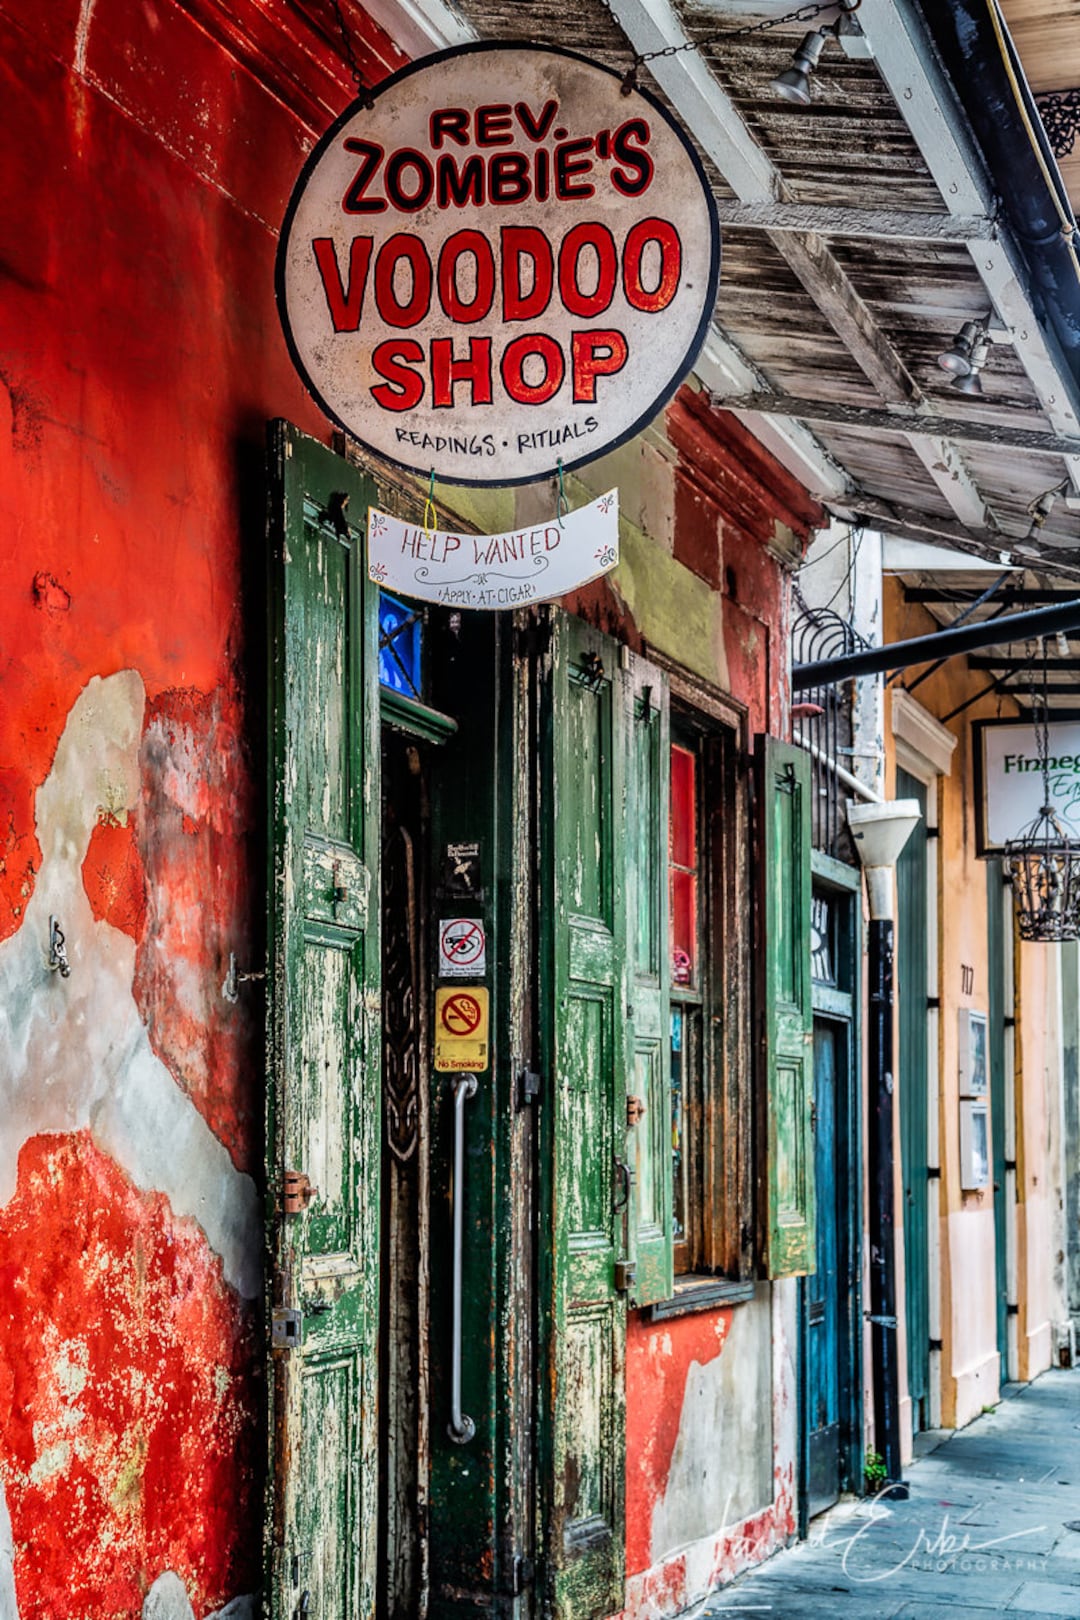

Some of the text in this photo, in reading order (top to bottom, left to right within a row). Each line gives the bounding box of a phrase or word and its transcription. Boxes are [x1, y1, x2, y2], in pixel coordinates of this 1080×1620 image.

[429, 100, 568, 148] REV.
[342, 118, 654, 214] ZOMBIE'S
[312, 217, 682, 333] VOODOO
[370, 328, 629, 412] SHOP
[395, 416, 599, 456] READINGS RITUALS
[401, 526, 561, 564] HELP WANTED
[438, 1060, 484, 1069] No Smoking
